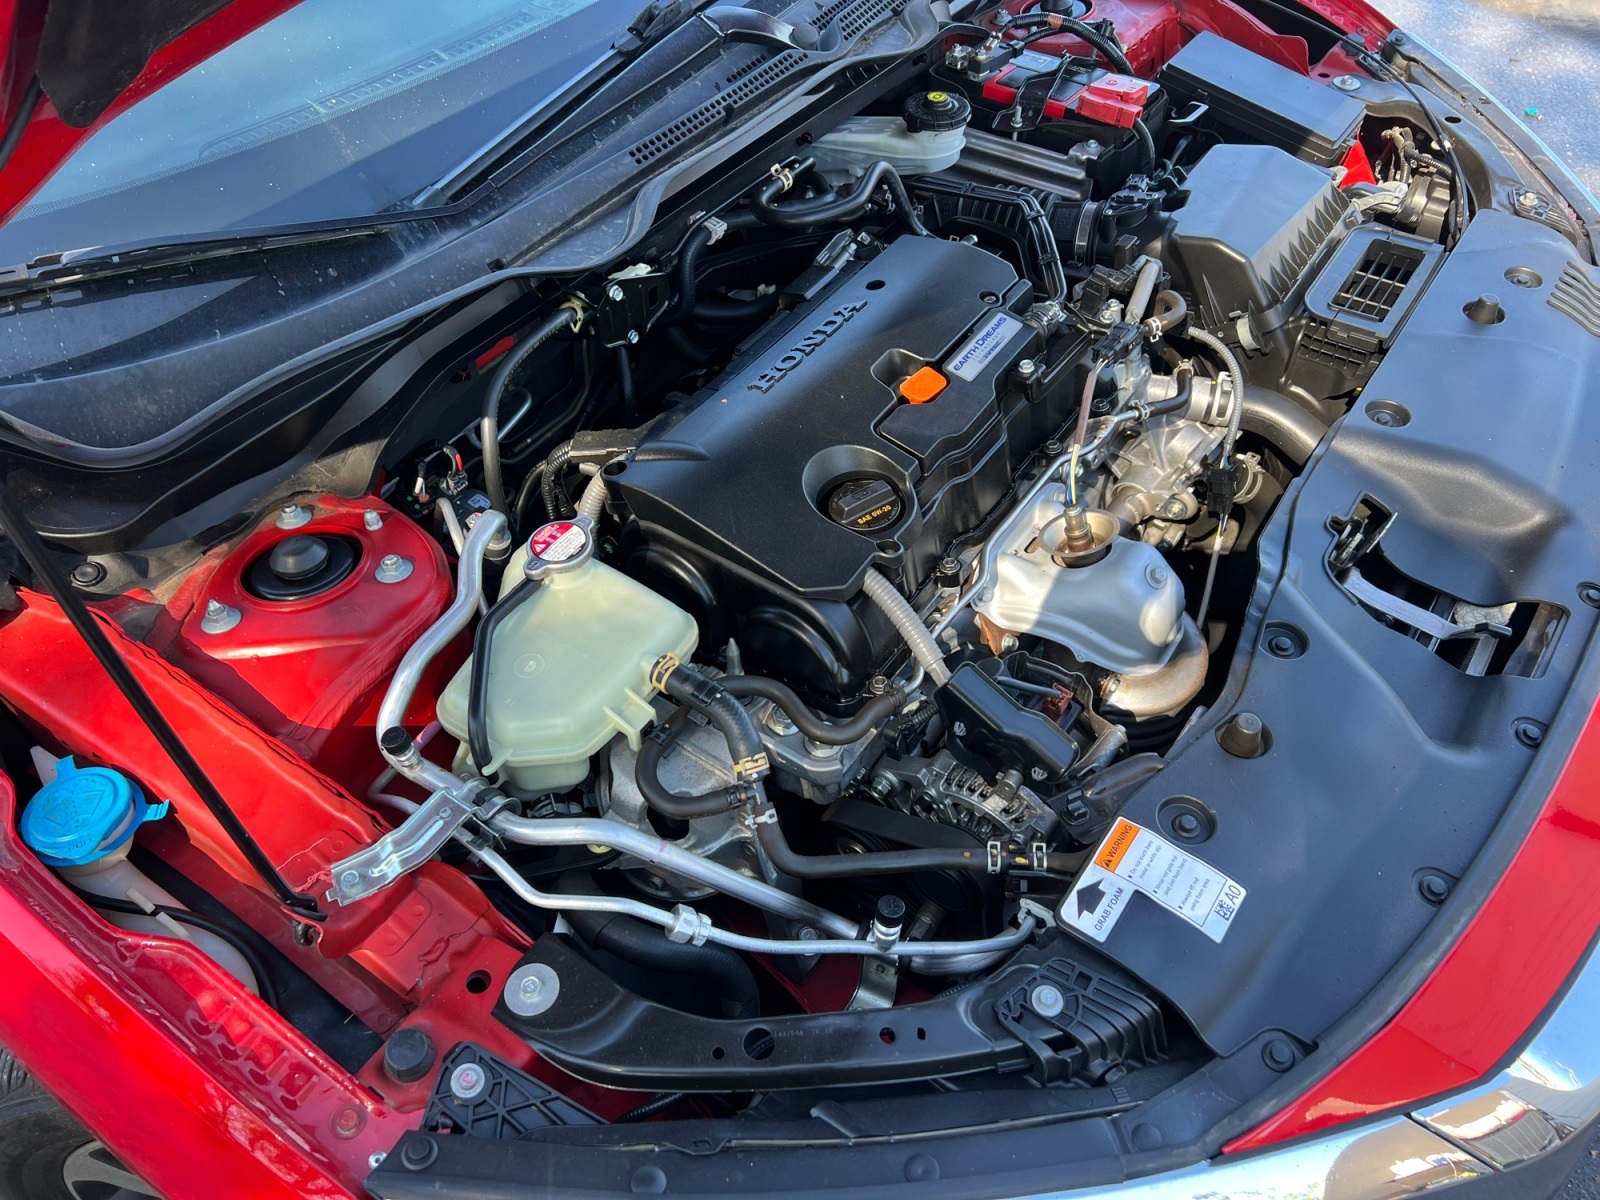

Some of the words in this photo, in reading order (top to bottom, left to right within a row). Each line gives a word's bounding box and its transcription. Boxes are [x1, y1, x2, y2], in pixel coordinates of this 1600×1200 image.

[747, 300, 868, 394] HONDA
[953, 345, 980, 371] EARTH
[975, 316, 1007, 347] DREAMS
[857, 514, 872, 524] SAE
[871, 504, 892, 518] 0W-20
[1107, 825, 1132, 857] WARNING
[1139, 849, 1148, 860] touch
[1172, 869, 1181, 879] burn
[1155, 877, 1164, 890] Metal
[1181, 890, 1192, 906] Always
[1190, 899, 1200, 911] using
[1094, 909, 1111, 931] GRAB
[1107, 887, 1124, 910] FOAM
